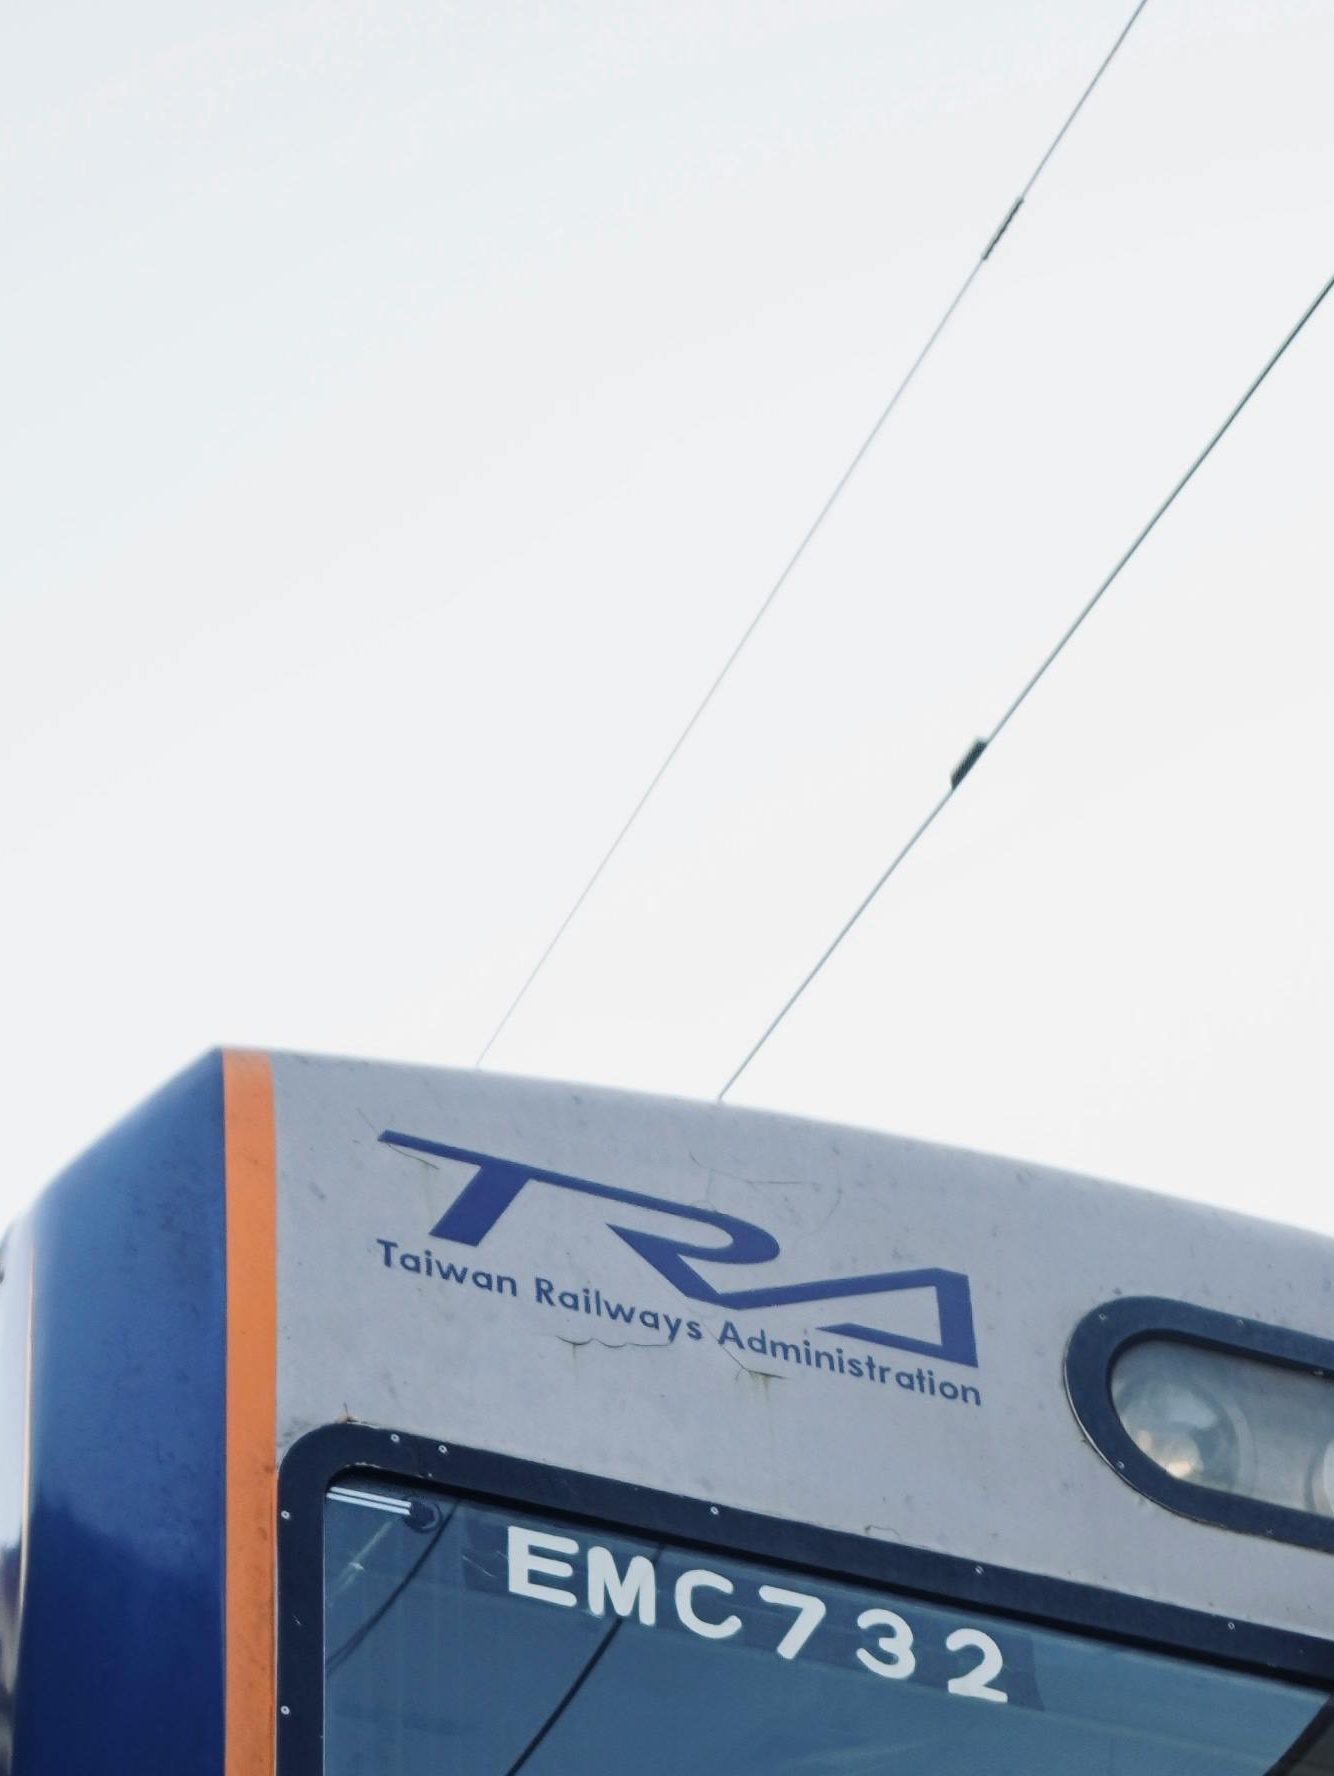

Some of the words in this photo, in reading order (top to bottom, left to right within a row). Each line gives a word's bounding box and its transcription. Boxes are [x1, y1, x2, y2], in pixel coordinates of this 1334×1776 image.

[376, 1238, 518, 1299] Taiwan
[534, 1276, 703, 1343] Railways
[718, 1319, 982, 1407] Administration
[377, 1129, 979, 1369] TRA
